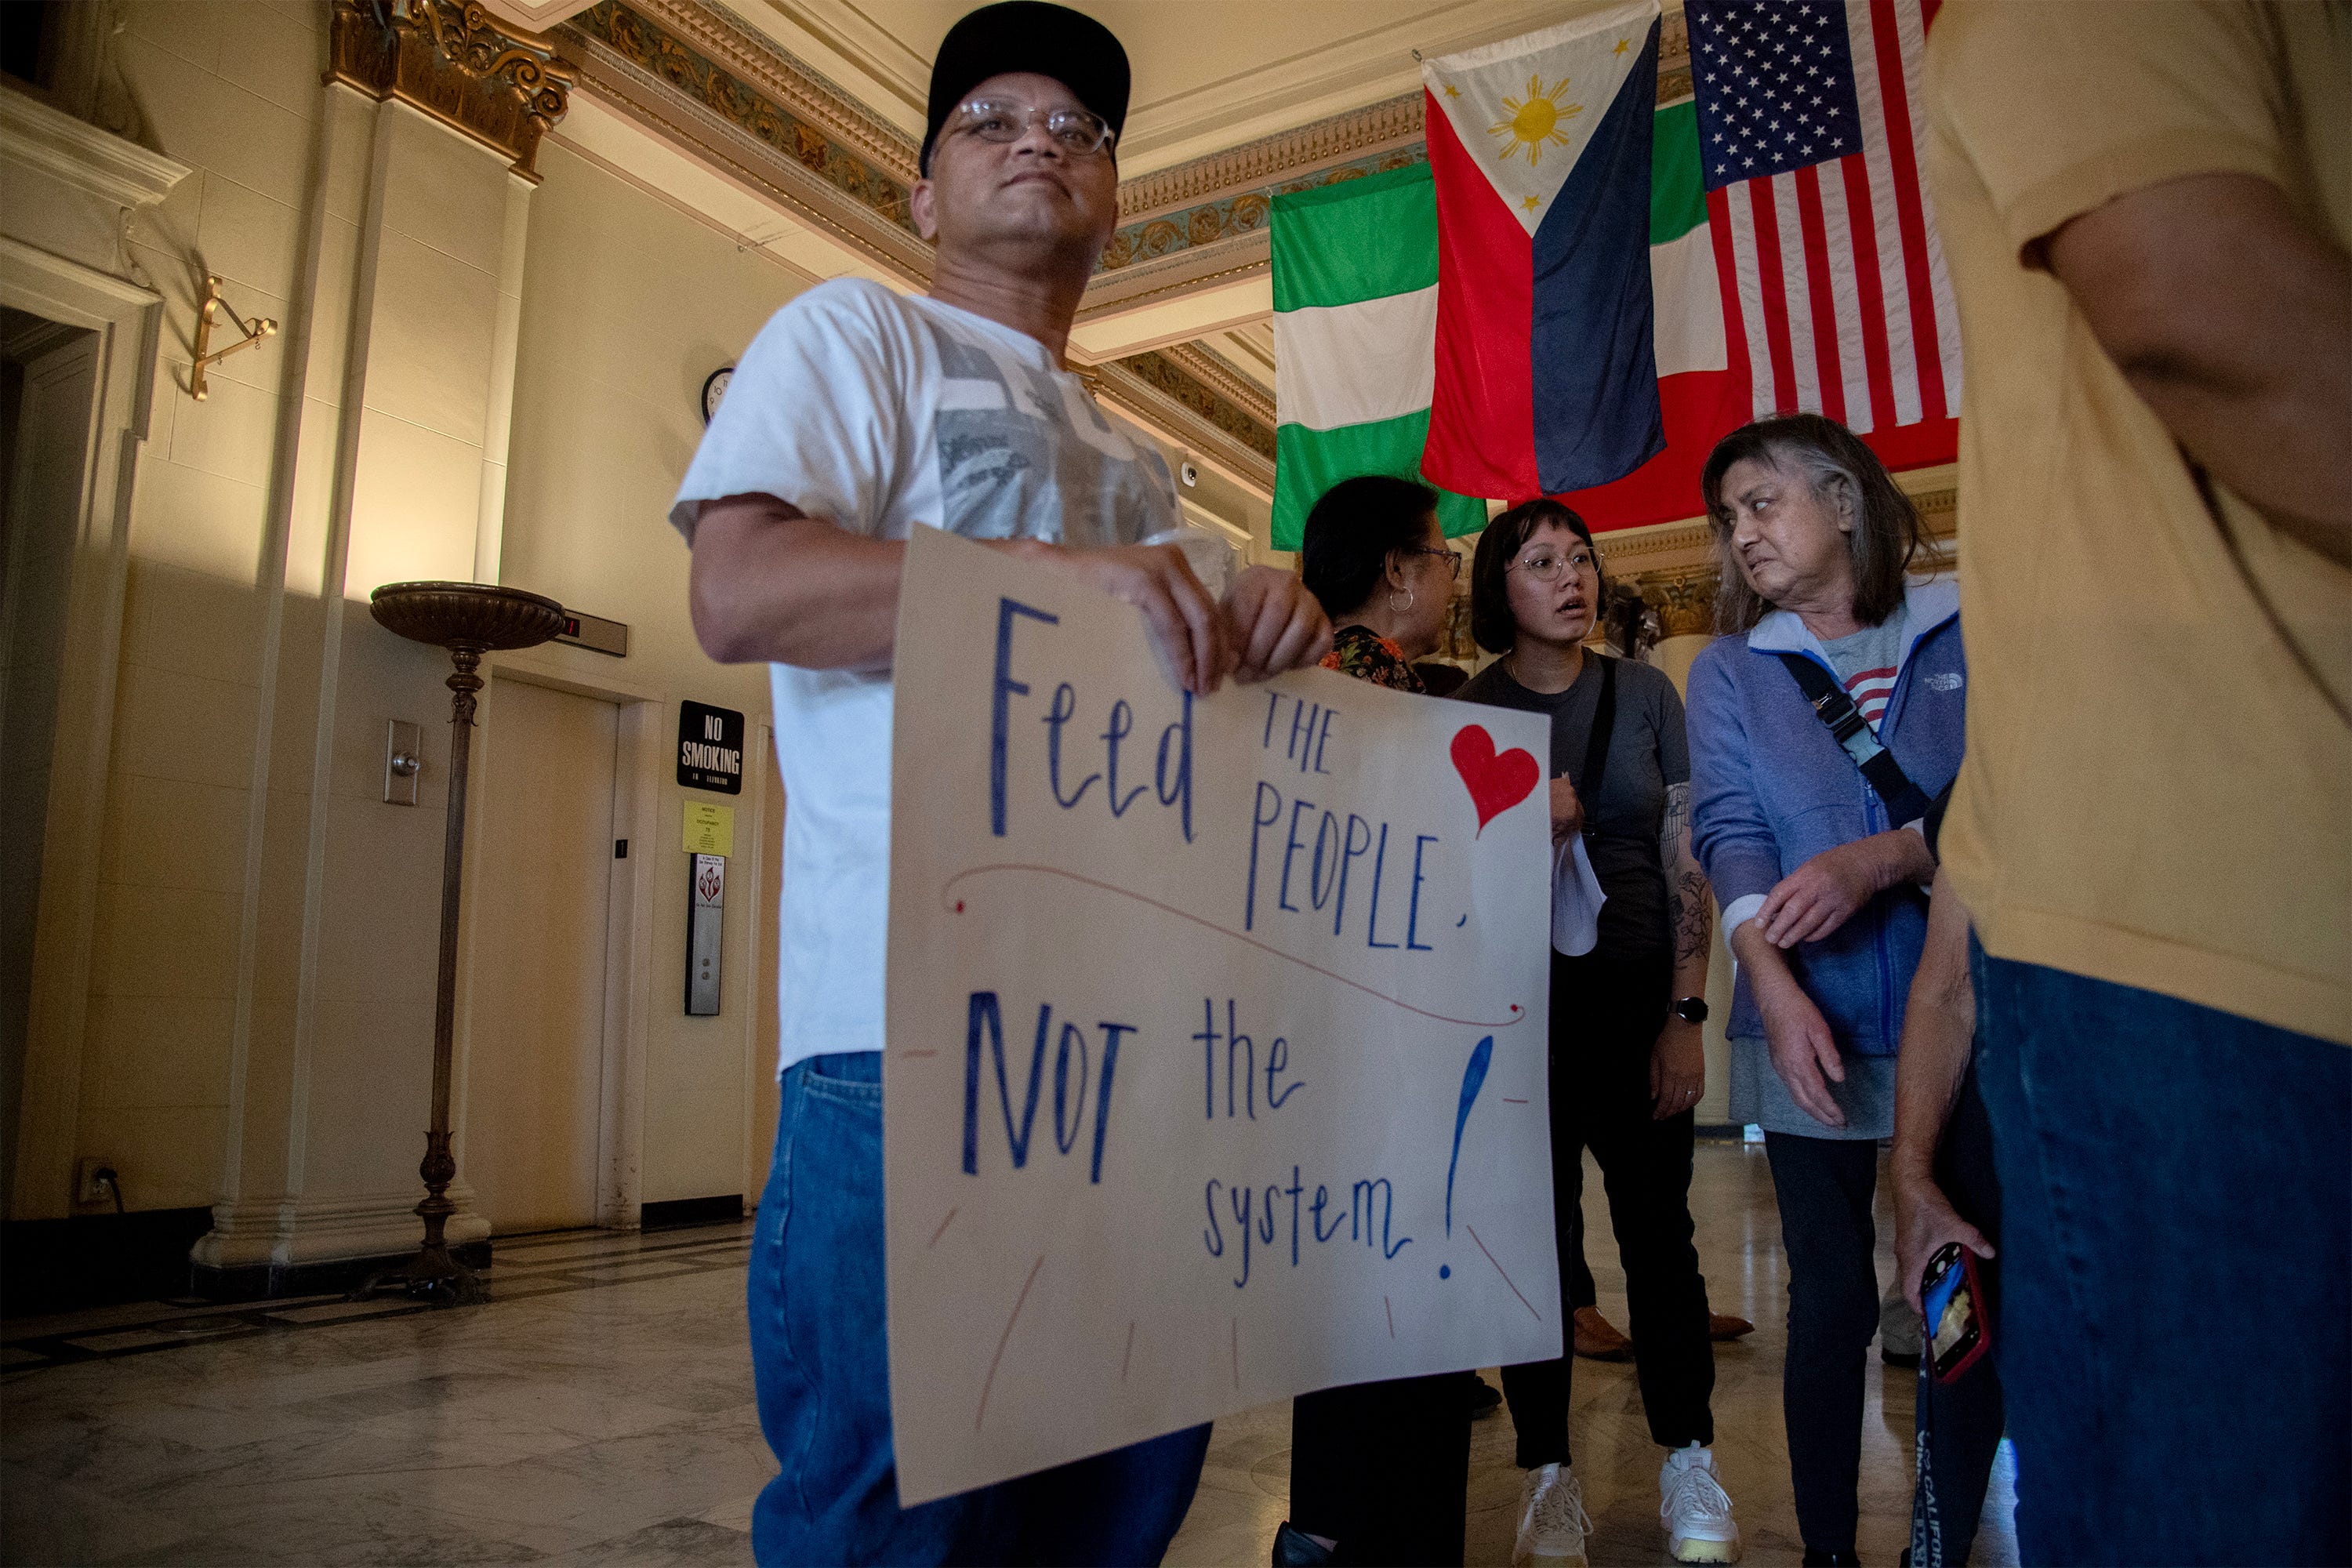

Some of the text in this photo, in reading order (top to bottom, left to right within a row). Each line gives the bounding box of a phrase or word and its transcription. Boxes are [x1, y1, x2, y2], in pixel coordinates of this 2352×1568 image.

[714, 386, 722, 395] 10
[704, 714, 723, 742] NO
[991, 597, 1341, 844] Feed THE
[681, 740, 740, 775] SMOKING
[962, 991, 1306, 1185] NOT the
